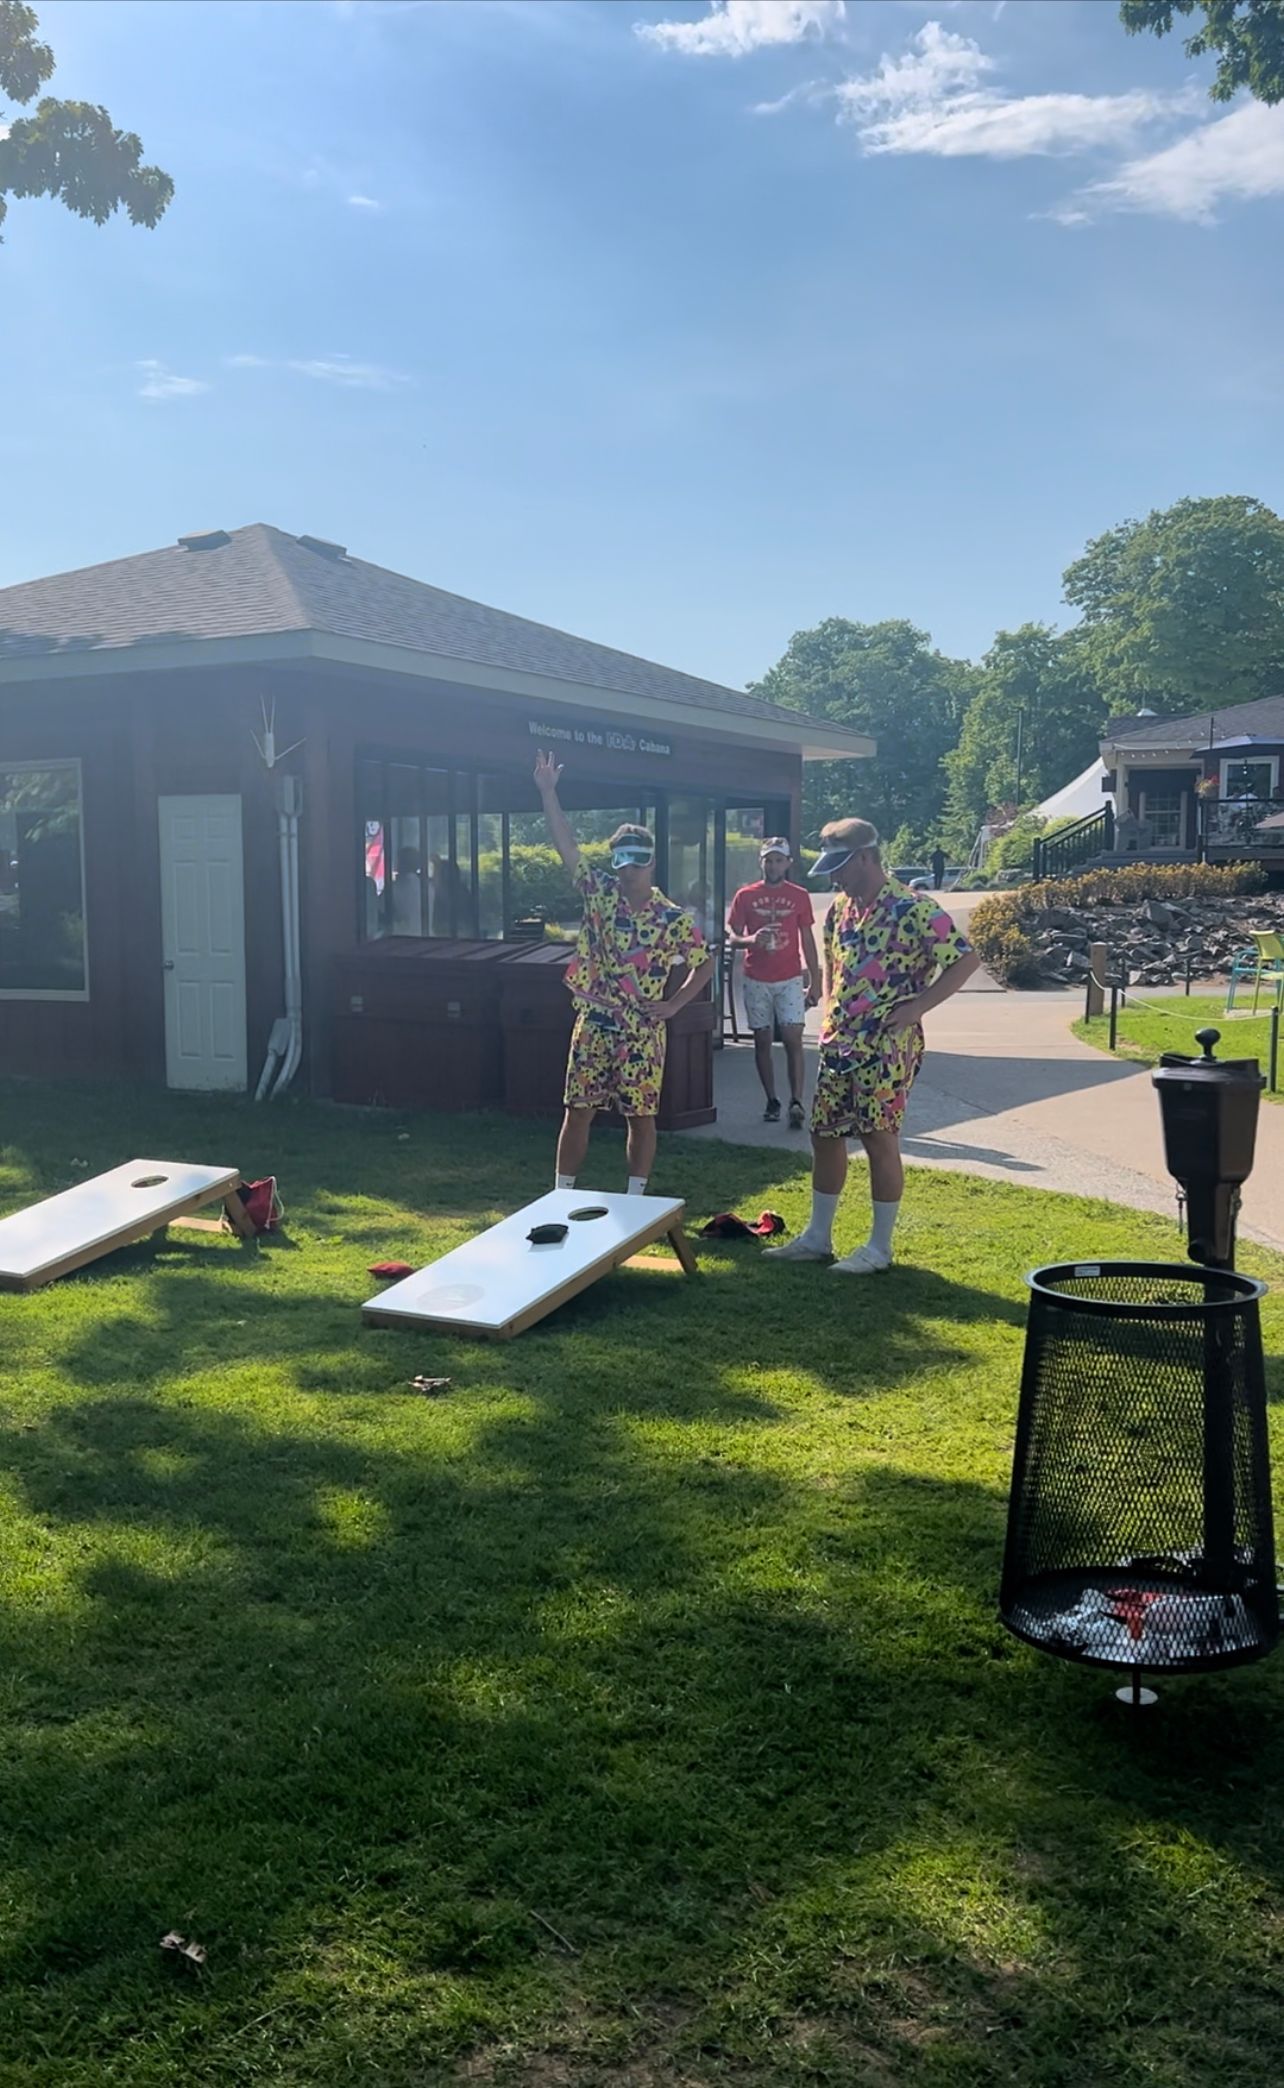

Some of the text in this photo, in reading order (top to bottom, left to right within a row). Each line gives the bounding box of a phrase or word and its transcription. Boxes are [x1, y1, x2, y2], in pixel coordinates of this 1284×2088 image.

[528, 720, 572, 740] Welcome
[574, 730, 585, 742] to
[587, 731, 603, 745] the
[640, 738, 670, 755] Cabana
